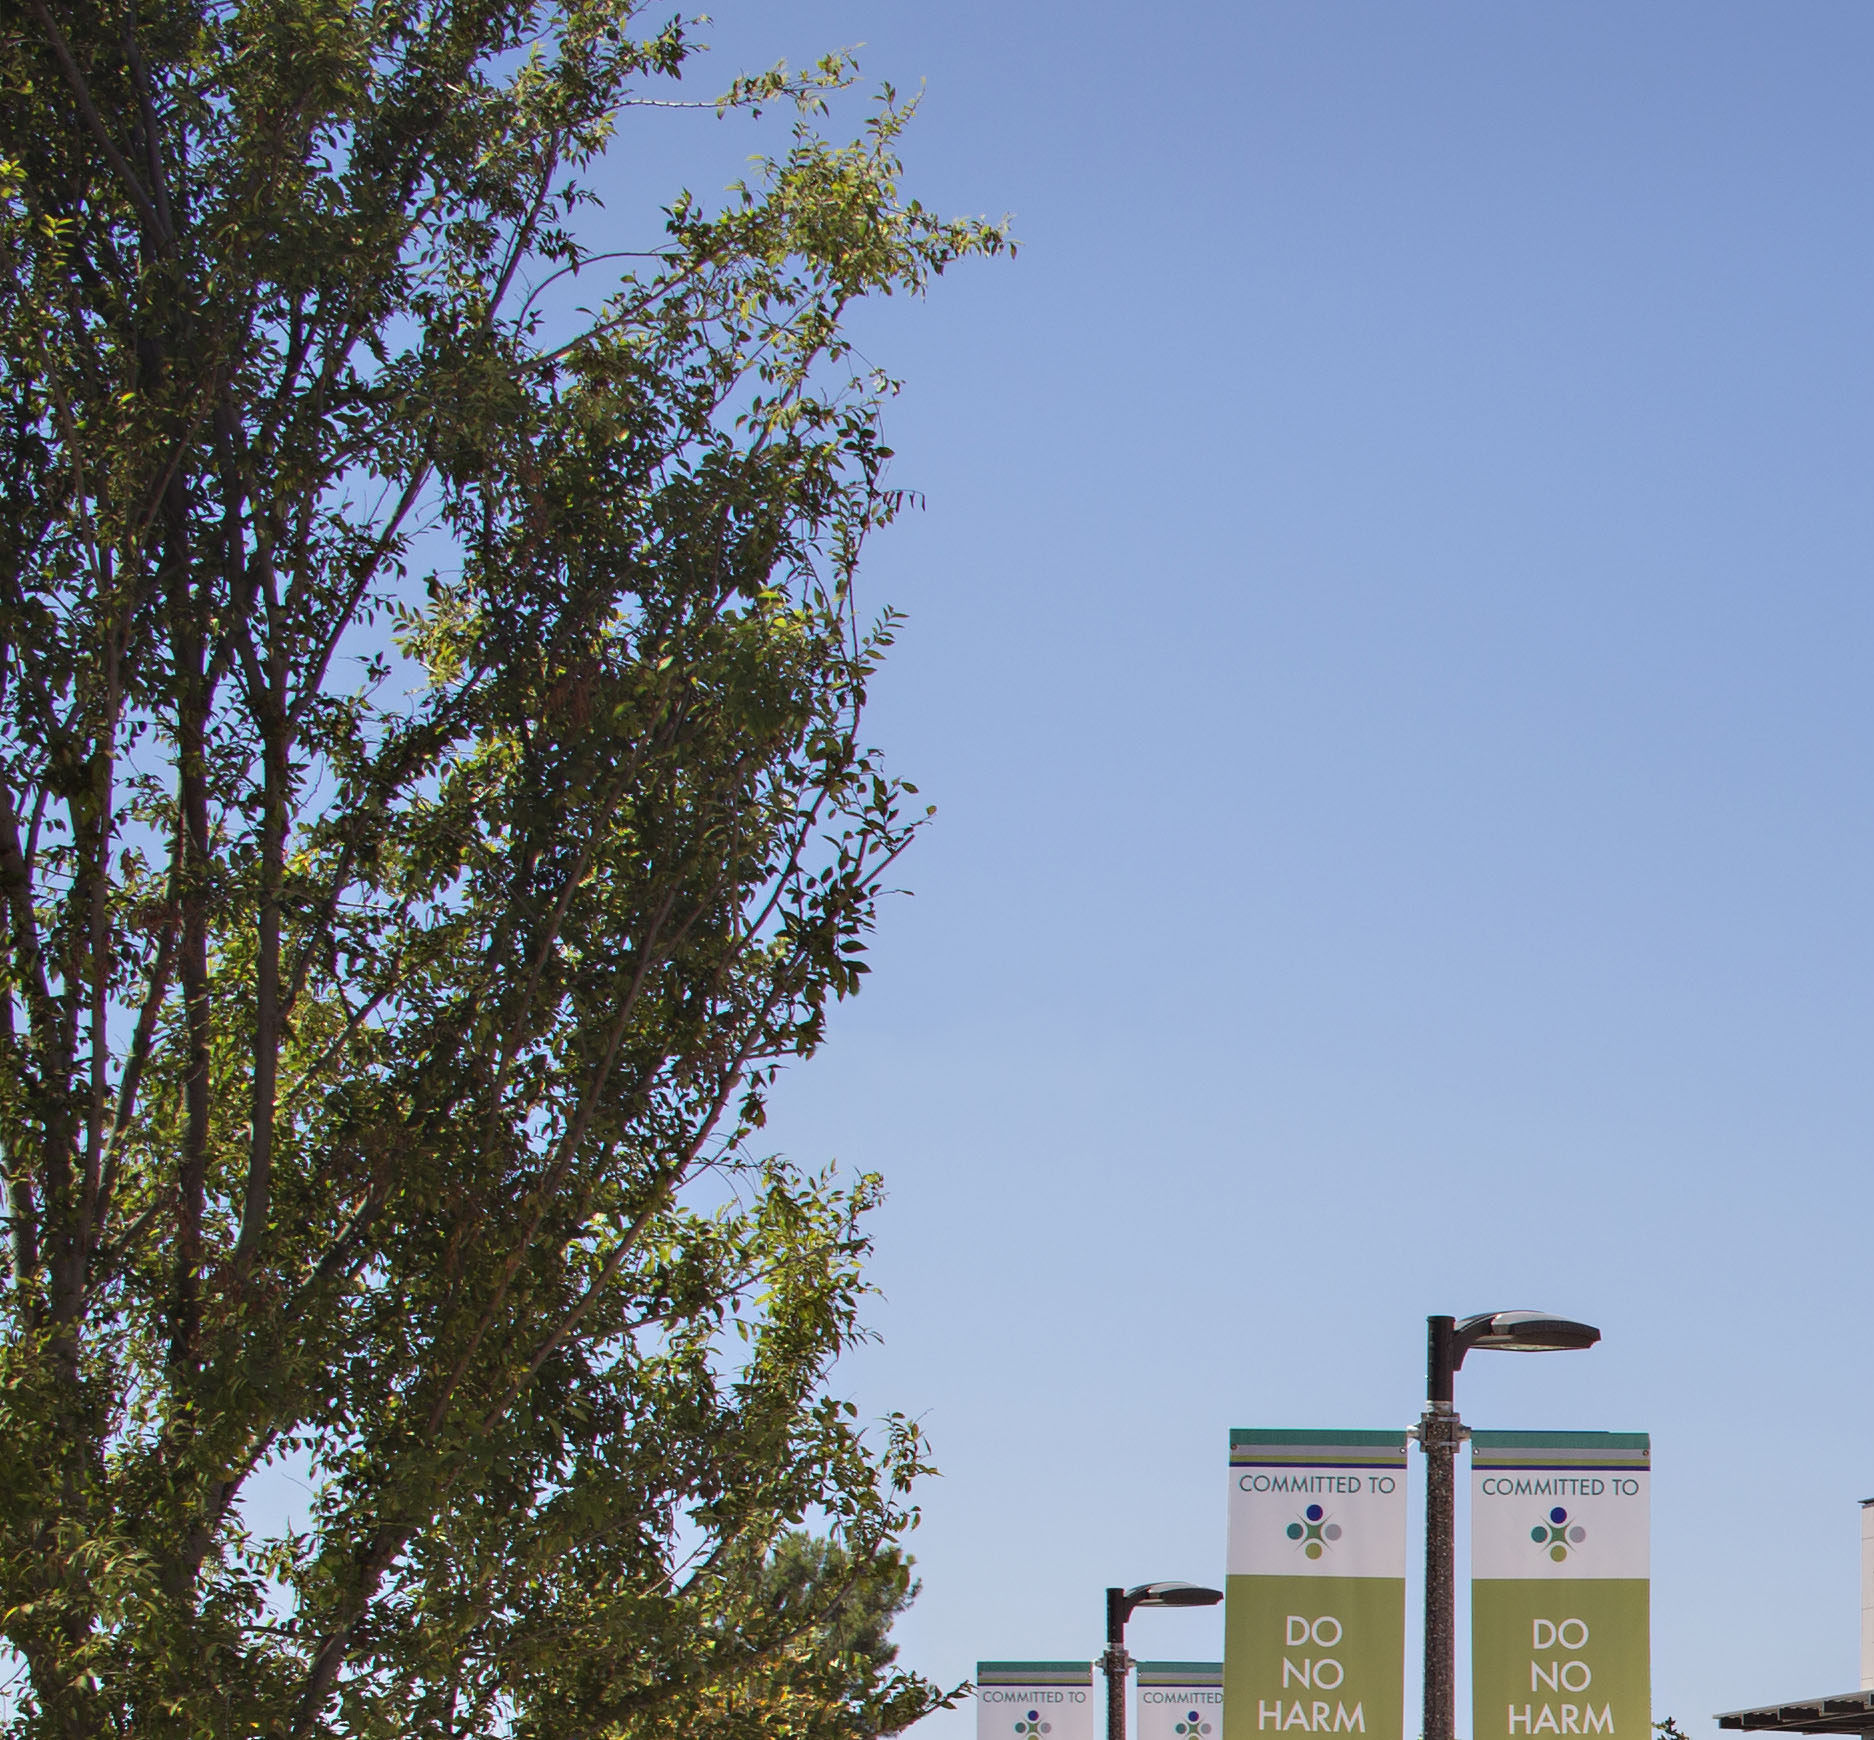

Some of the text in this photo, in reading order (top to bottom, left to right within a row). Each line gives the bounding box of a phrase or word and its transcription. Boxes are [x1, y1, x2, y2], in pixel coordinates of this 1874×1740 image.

[1239, 1474, 1397, 1495] COMMITTED TO
[1482, 1477, 1640, 1497] COMMITTED TO
[1286, 1616, 1343, 1648] DO
[1533, 1618, 1589, 1649] DO
[1283, 1658, 1345, 1690] NO
[1531, 1660, 1592, 1692] NO
[982, 1690, 1087, 1704] COMMITTED TO
[1143, 1692, 1223, 1703] COMMITTED
[1258, 1700, 1366, 1732] HARM
[1508, 1703, 1615, 1735] HARM
